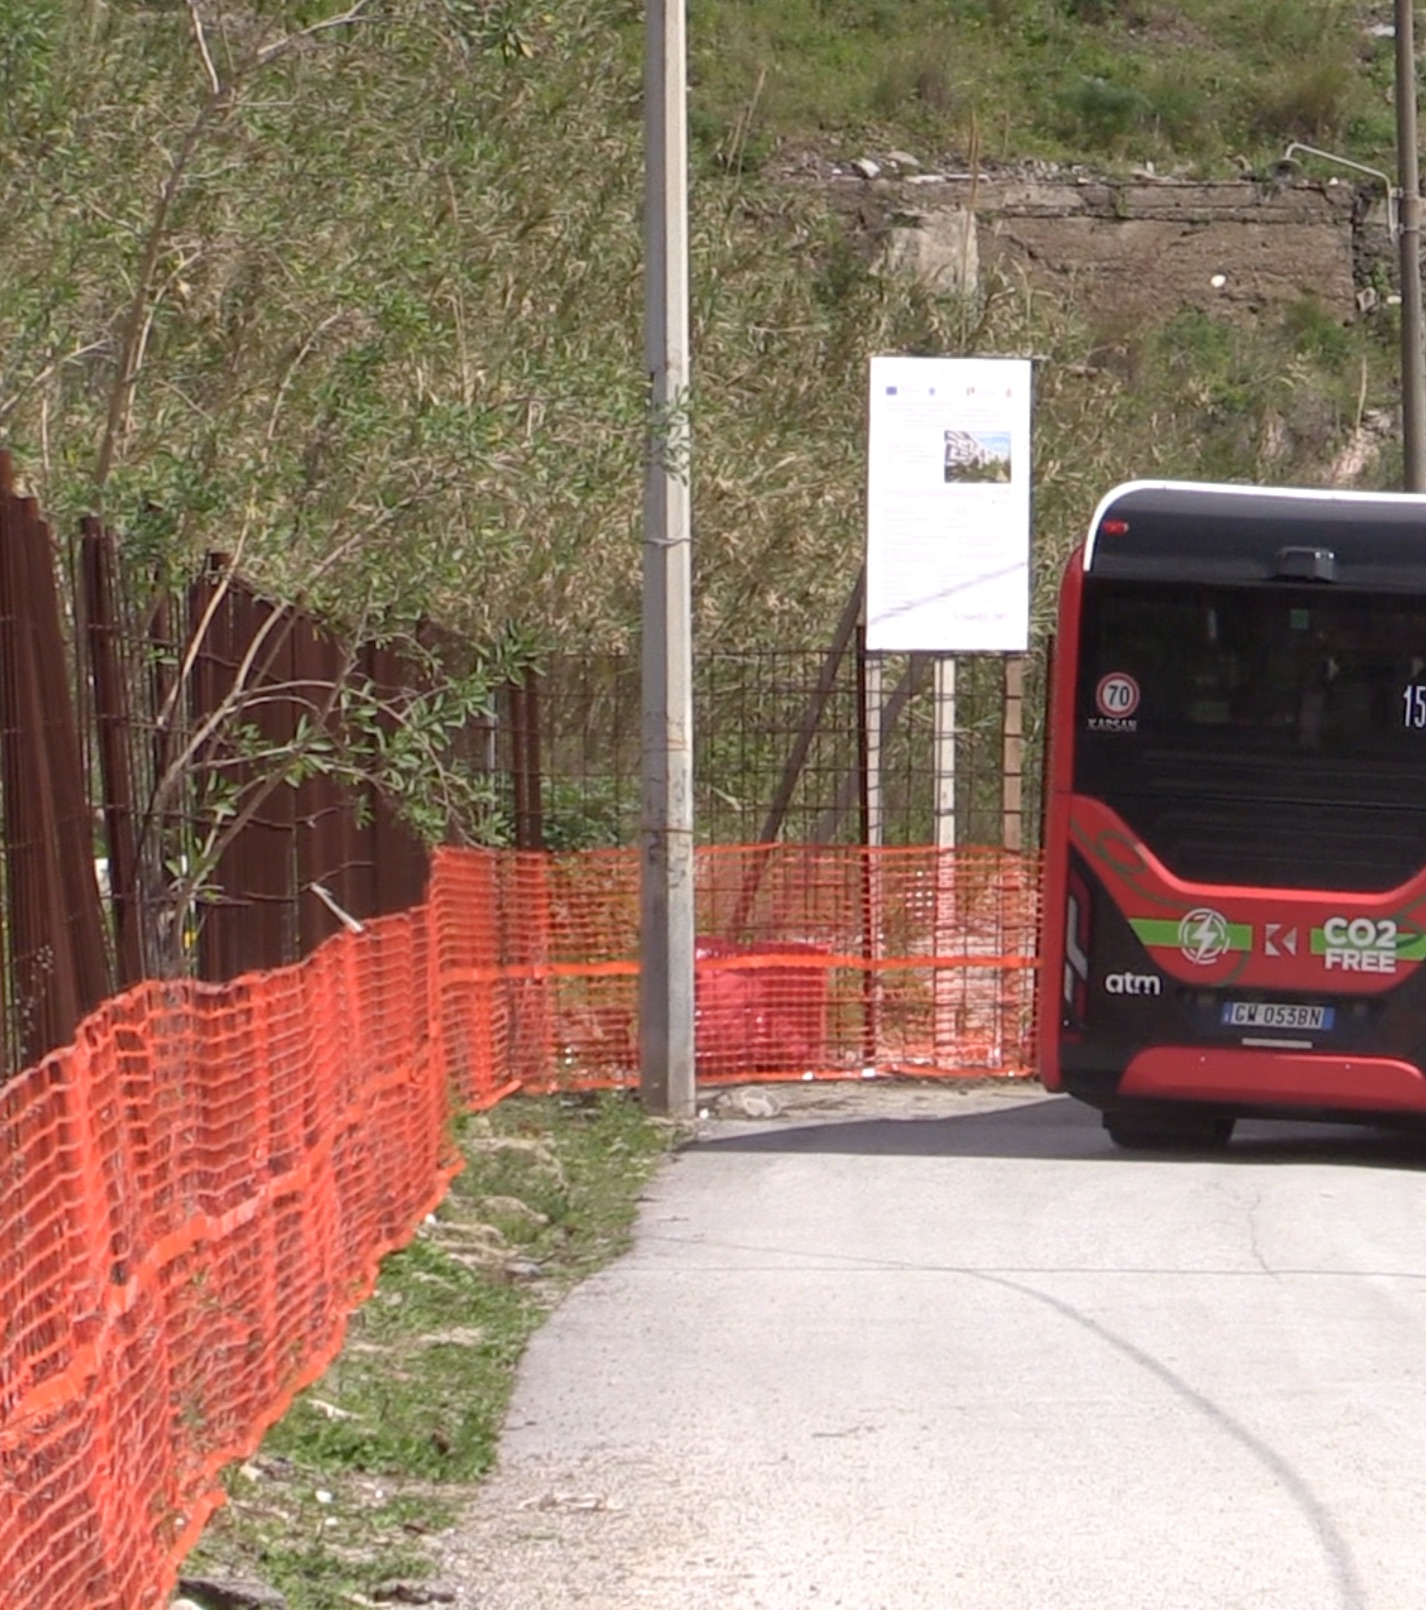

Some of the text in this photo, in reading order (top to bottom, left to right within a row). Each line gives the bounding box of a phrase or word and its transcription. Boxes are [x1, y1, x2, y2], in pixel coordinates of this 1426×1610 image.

[1108, 685, 1130, 706] 70
[1324, 917, 1397, 948] CO2
[1325, 948, 1396, 973] FREE
[1105, 972, 1161, 995] atm
[1264, 1006, 1321, 1026] 053BN
